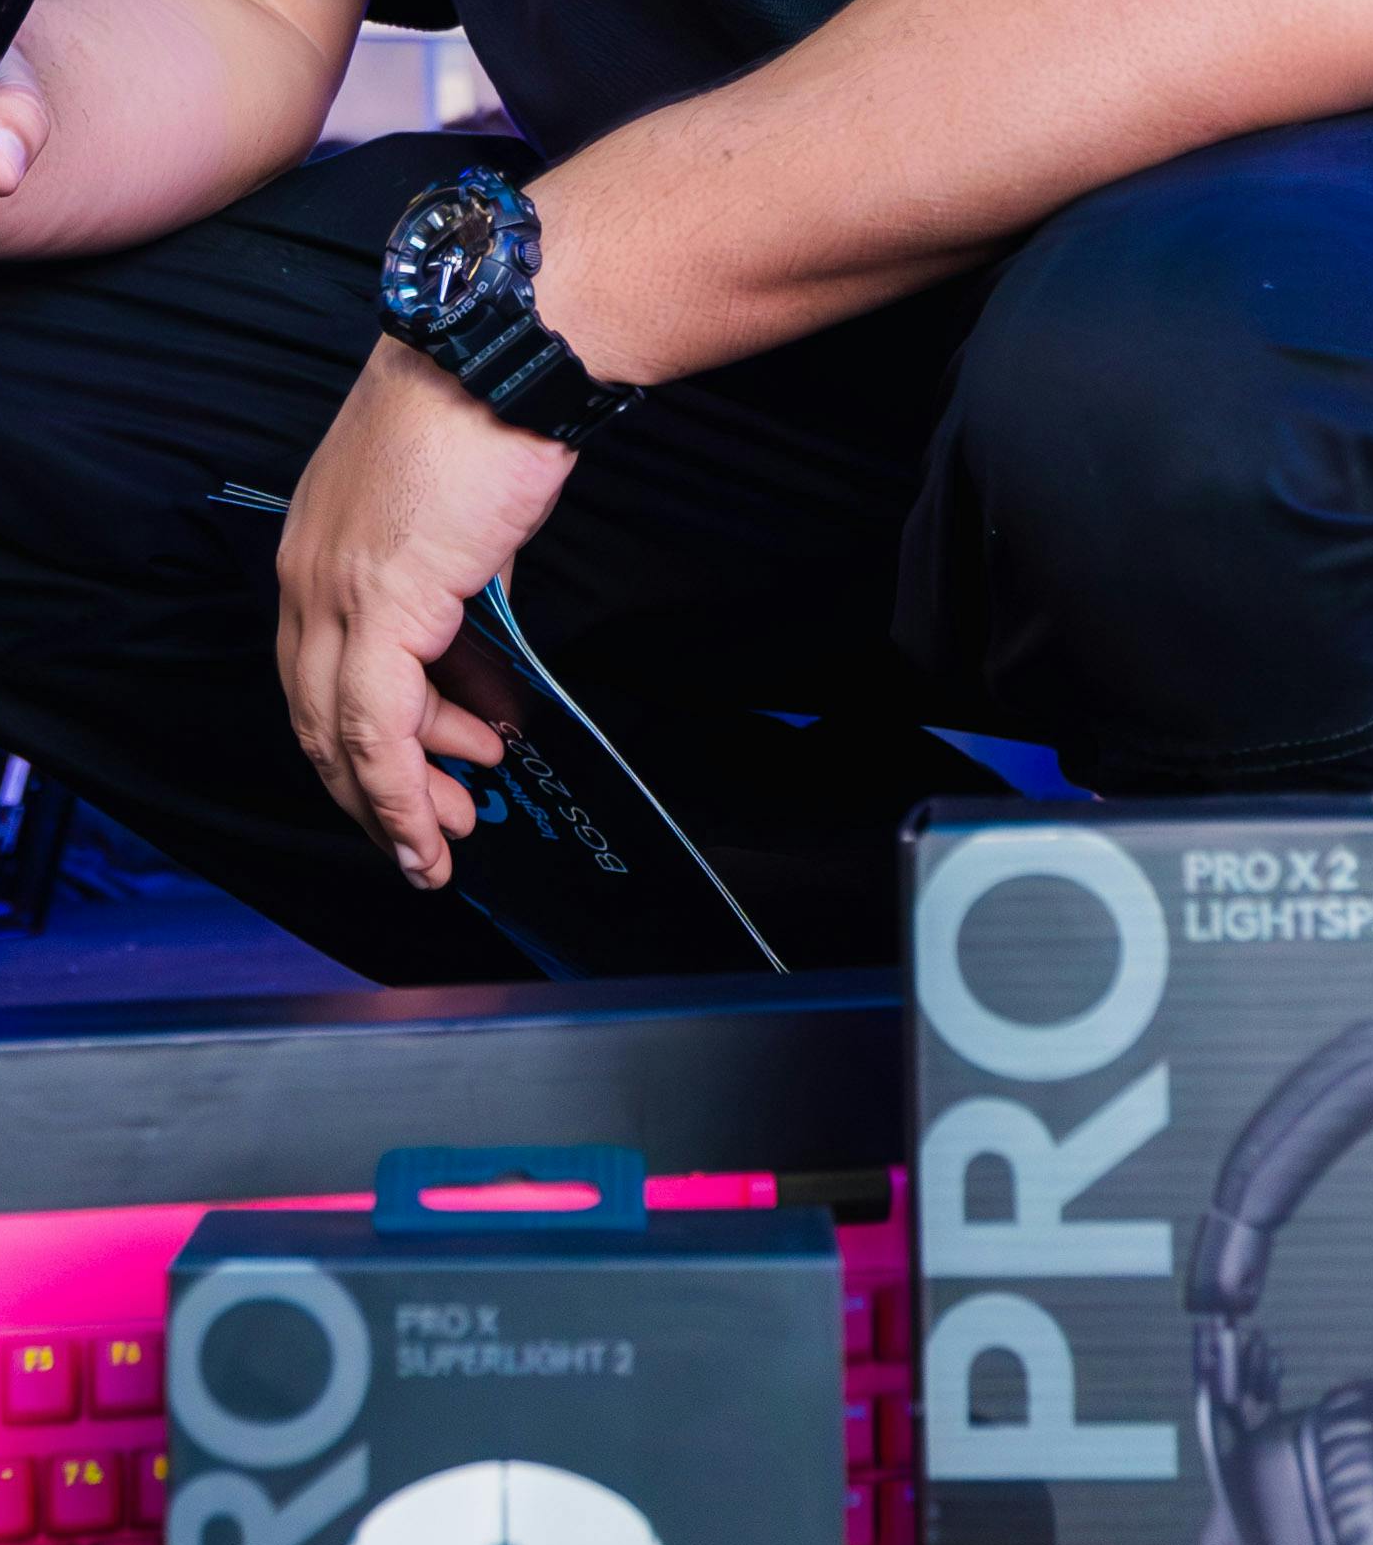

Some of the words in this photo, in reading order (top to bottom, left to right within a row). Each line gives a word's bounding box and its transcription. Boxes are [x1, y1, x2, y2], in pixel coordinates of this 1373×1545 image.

[427, 281, 489, 334] G-SHOCK
[494, 765, 559, 840] logitec
[559, 805, 628, 873] BGS
[1183, 849, 1282, 893] PRO
[1287, 850, 1324, 892] X
[1328, 845, 1359, 891] 2
[915, 825, 1179, 1481] PRO
[395, 1303, 470, 1338] PRO
